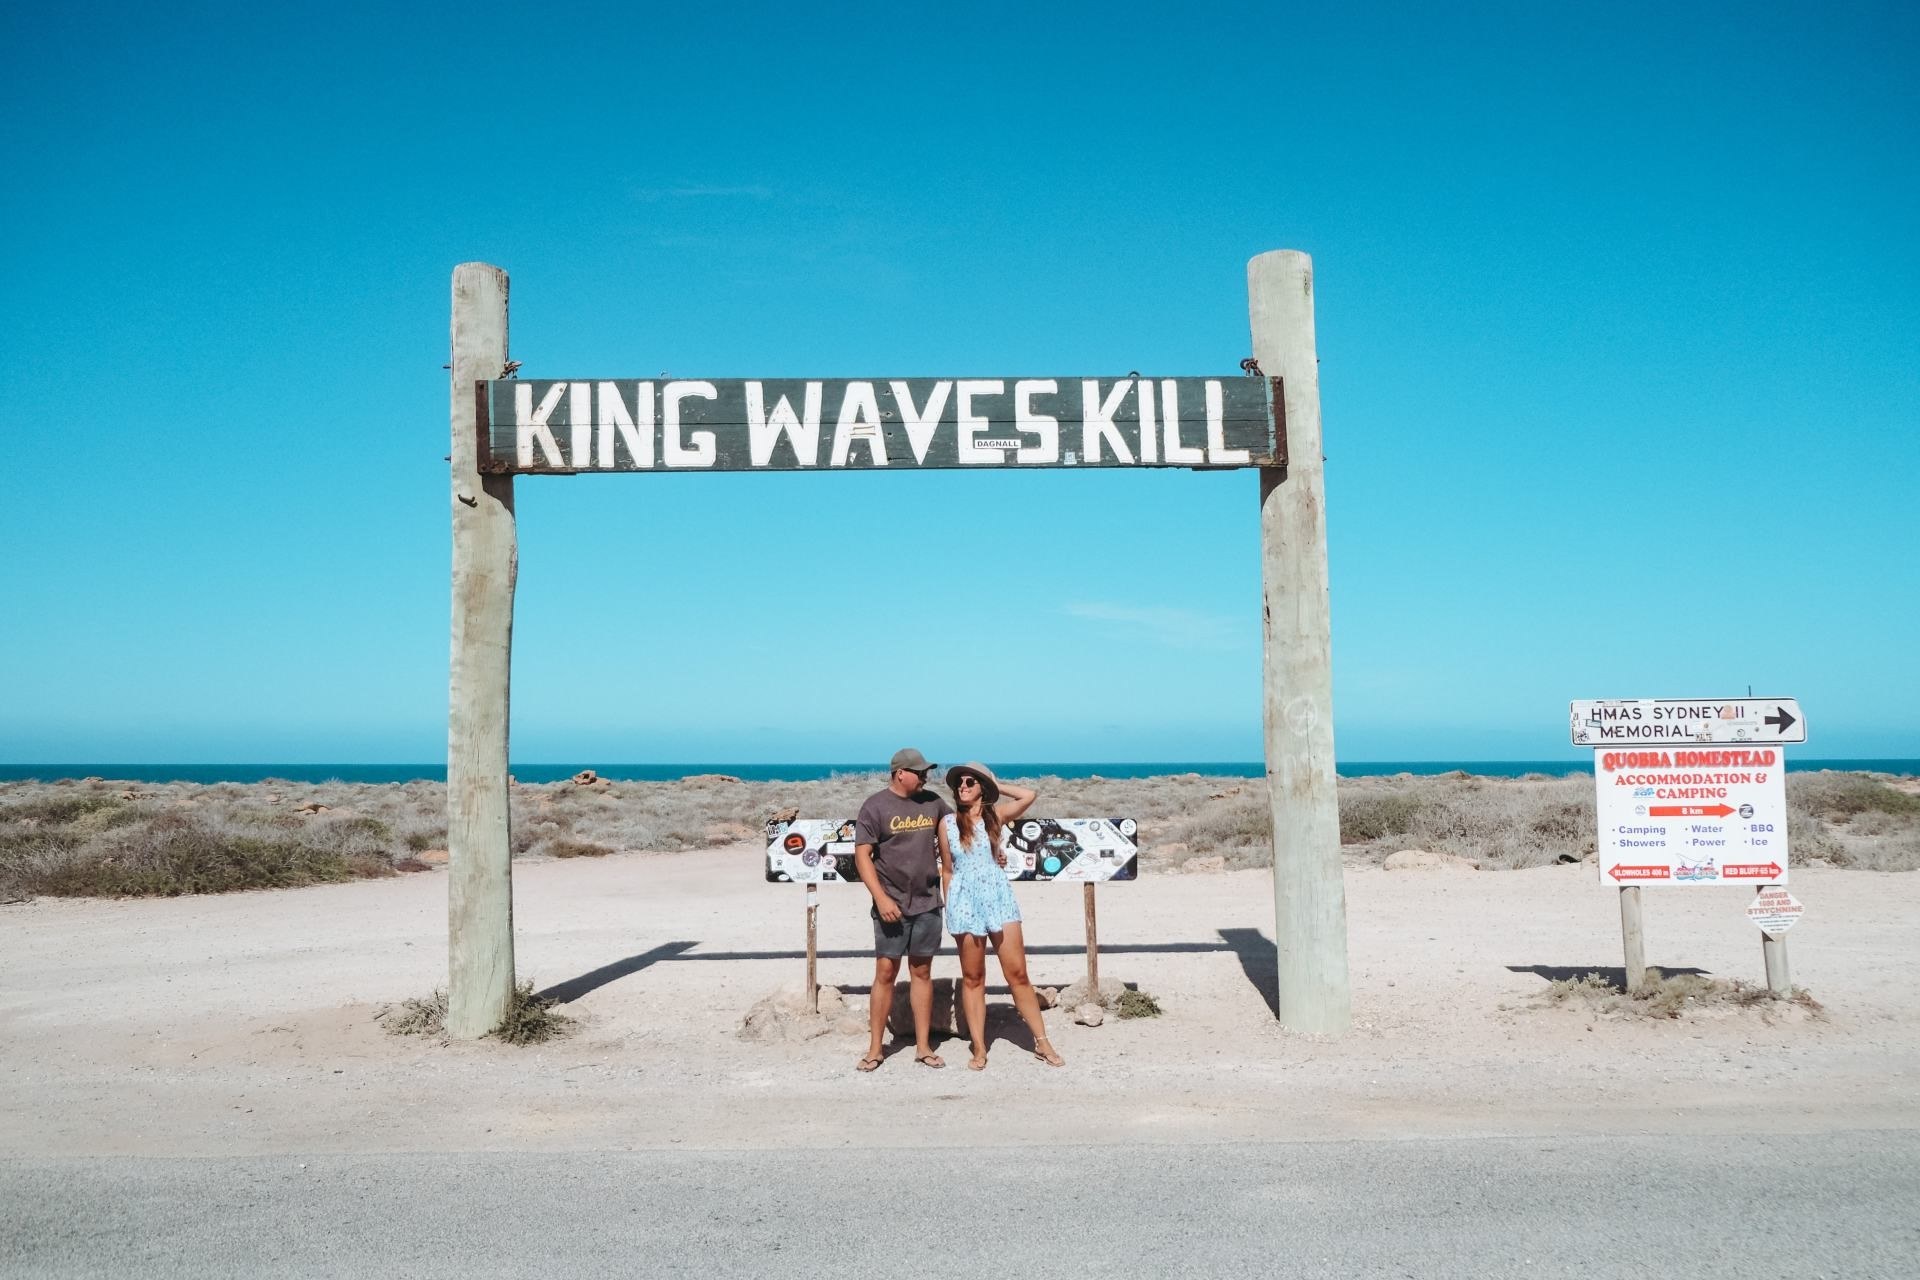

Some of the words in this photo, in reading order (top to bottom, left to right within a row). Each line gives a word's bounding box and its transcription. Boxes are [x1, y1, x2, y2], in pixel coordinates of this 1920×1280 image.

[515, 381, 718, 468] KING
[744, 378, 1059, 467] WAVES
[1082, 378, 1250, 465] KILL
[1591, 707, 1642, 721] HMAS
[1653, 706, 1724, 720] SYDNEY
[1600, 725, 1694, 738] MEMORIAL
[1603, 752, 1672, 772] QUOBBA
[1674, 750, 1776, 768] HOMESTEAD
[1615, 773, 1751, 786] ACCOMMODATION
[1755, 773, 1767, 784] &
[1656, 787, 1728, 799] CAMPING
[890, 814, 934, 830] Cabela's
[1618, 825, 1666, 836] Camping
[1691, 824, 1723, 833] Water
[1750, 824, 1774, 832] BBQ
[1619, 839, 1666, 847] Showers
[1692, 838, 1726, 847] Power
[1751, 838, 1768, 846] Ice
[1614, 869, 1650, 877] BLOWHOLES
[1725, 867, 1738, 875] RED
[1760, 892, 1788, 900] DANGER
[1747, 905, 1803, 915] STRYCHNINE
